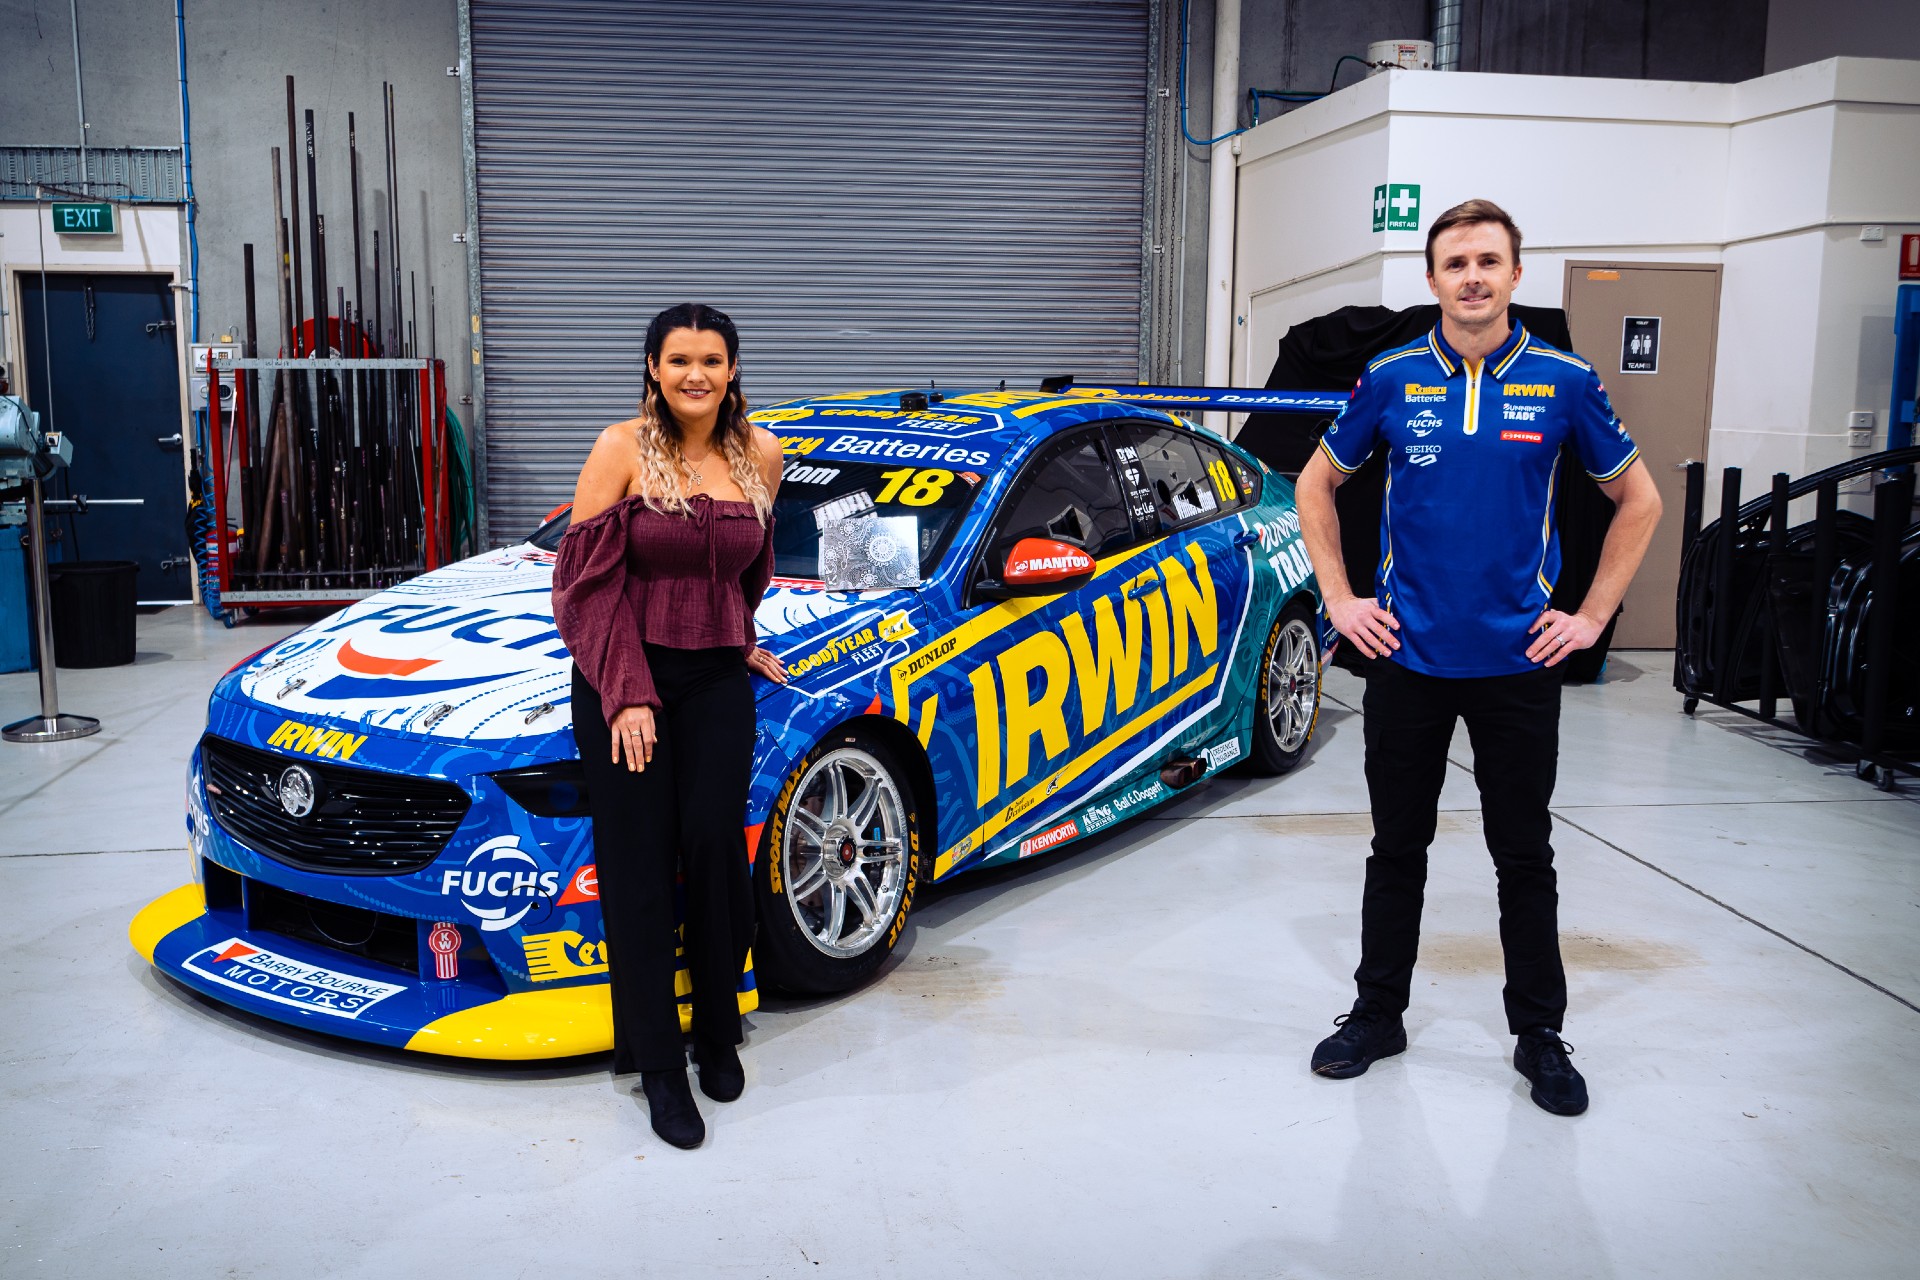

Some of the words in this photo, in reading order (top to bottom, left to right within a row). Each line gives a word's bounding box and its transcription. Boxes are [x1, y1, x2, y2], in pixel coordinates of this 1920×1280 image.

[63, 208, 101, 227] EXIT
[1405, 394, 1447, 403] Batteries
[1503, 384, 1556, 397] IRWIN
[1503, 403, 1546, 413] BUNNINGS
[1503, 411, 1536, 421] TRADE
[897, 418, 969, 432] FLEET
[1406, 419, 1443, 428] FUCHS
[1513, 433, 1541, 441] HINO
[826, 435, 991, 466] Batteries
[1405, 445, 1442, 454] SEIKO
[874, 467, 955, 507] 18
[1208, 459, 1237, 502] 18
[1029, 556, 1090, 571] MANITOU
[1268, 538, 1314, 594] TRAD
[787, 627, 877, 677] GOODYEAR
[850, 642, 884, 666] FLEET
[908, 637, 957, 676] DUNLOP
[968, 541, 1219, 810] IRWIN
[266, 719, 368, 761] IRWIN
[1113, 795, 1131, 812] Ball
[1135, 780, 1164, 803] Doggett
[770, 819, 785, 894] SPORT
[778, 757, 809, 815] MAXX
[1031, 823, 1077, 852] KENWORTH
[441, 869, 559, 898] FUCHS
[888, 832, 920, 949] DUNLOP
[222, 964, 364, 1009] MOTORS
[248, 953, 309, 978] BARRY
[304, 970, 389, 998] BOURKE
